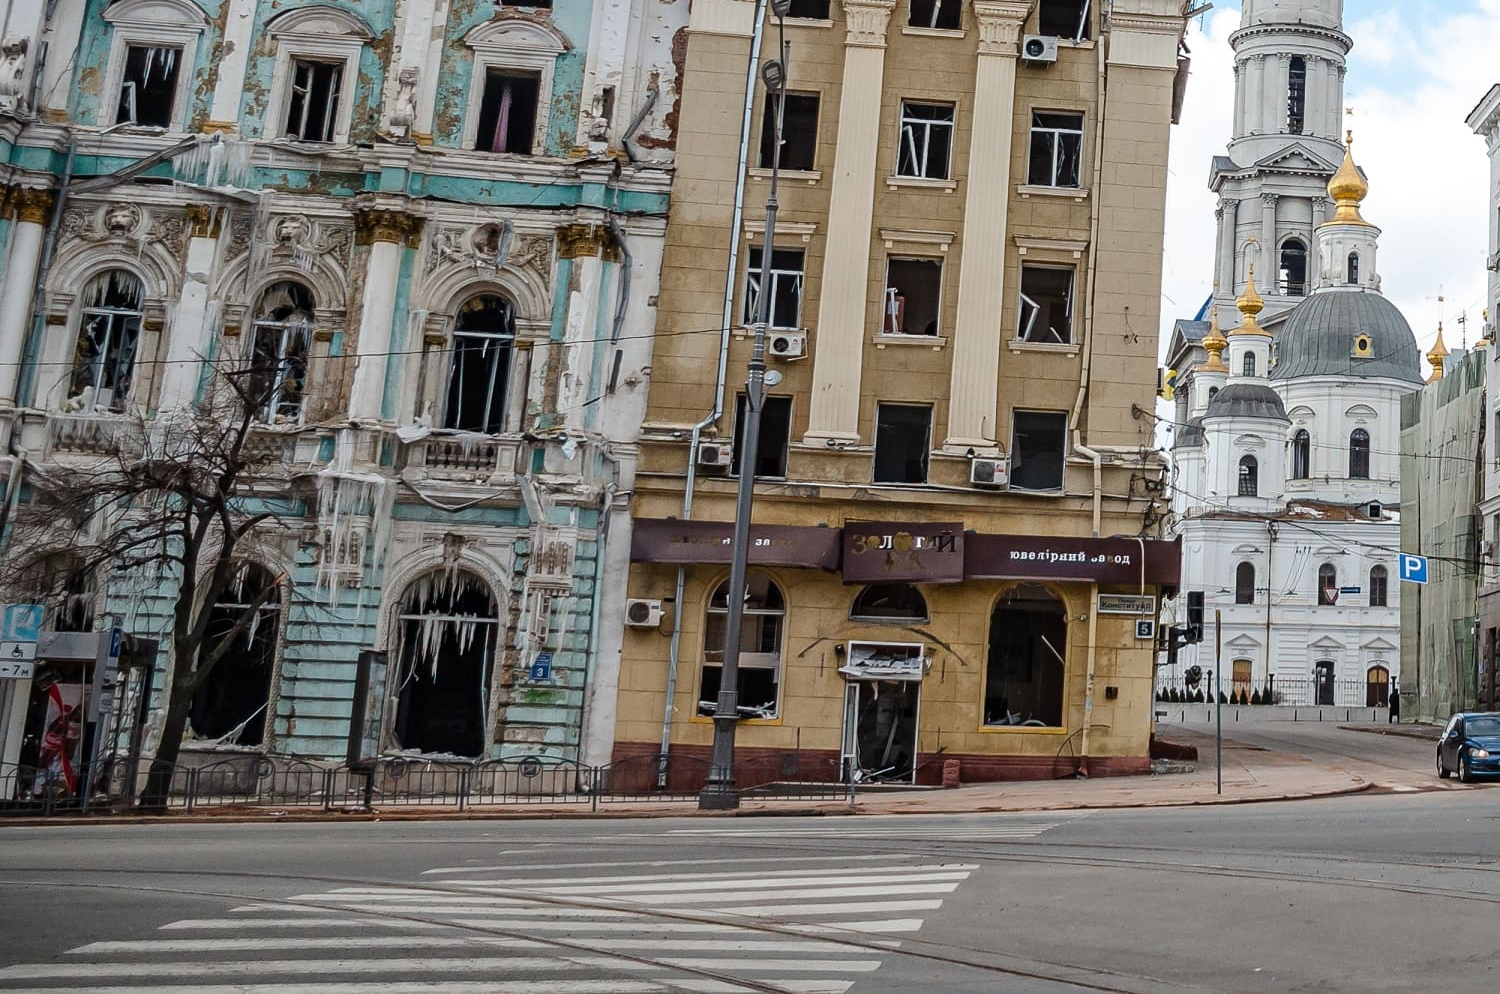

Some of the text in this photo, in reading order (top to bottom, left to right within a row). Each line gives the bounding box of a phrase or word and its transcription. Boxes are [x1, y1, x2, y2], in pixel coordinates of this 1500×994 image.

[1010, 549, 1086, 563] ювелірний
[1405, 557, 1422, 578] P
[1141, 623, 1149, 635] 5
[13, 664, 21, 676] 7
[536, 667, 544, 677] 3
